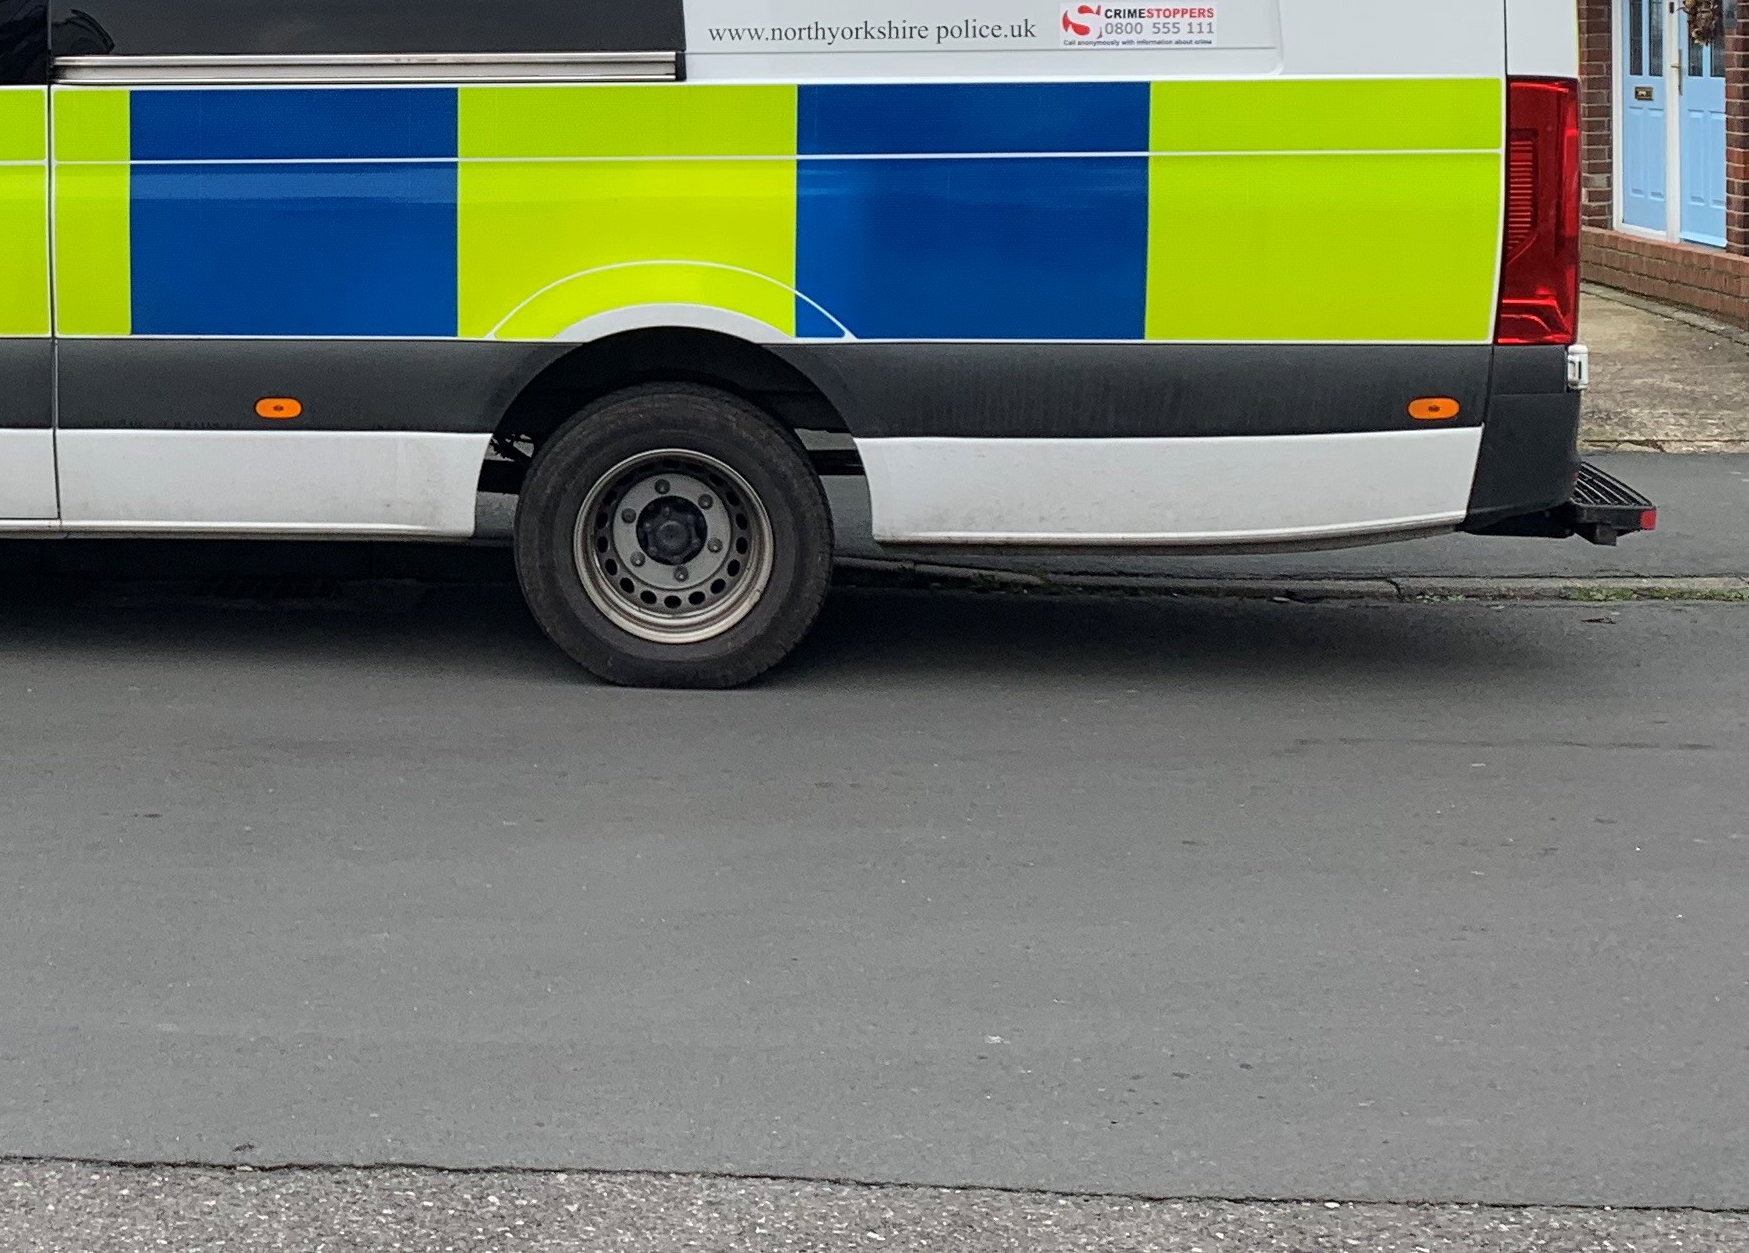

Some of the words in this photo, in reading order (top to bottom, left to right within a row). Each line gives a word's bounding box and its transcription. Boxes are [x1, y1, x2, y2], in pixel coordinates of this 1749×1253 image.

[1104, 8, 1214, 19] CRIMESTOPPERS
[708, 20, 929, 45] www.northyorkshire
[936, 19, 1037, 44] police.uk
[1105, 23, 1143, 35] 0800
[1152, 22, 1181, 34] 555
[1187, 21, 1214, 34] 111
